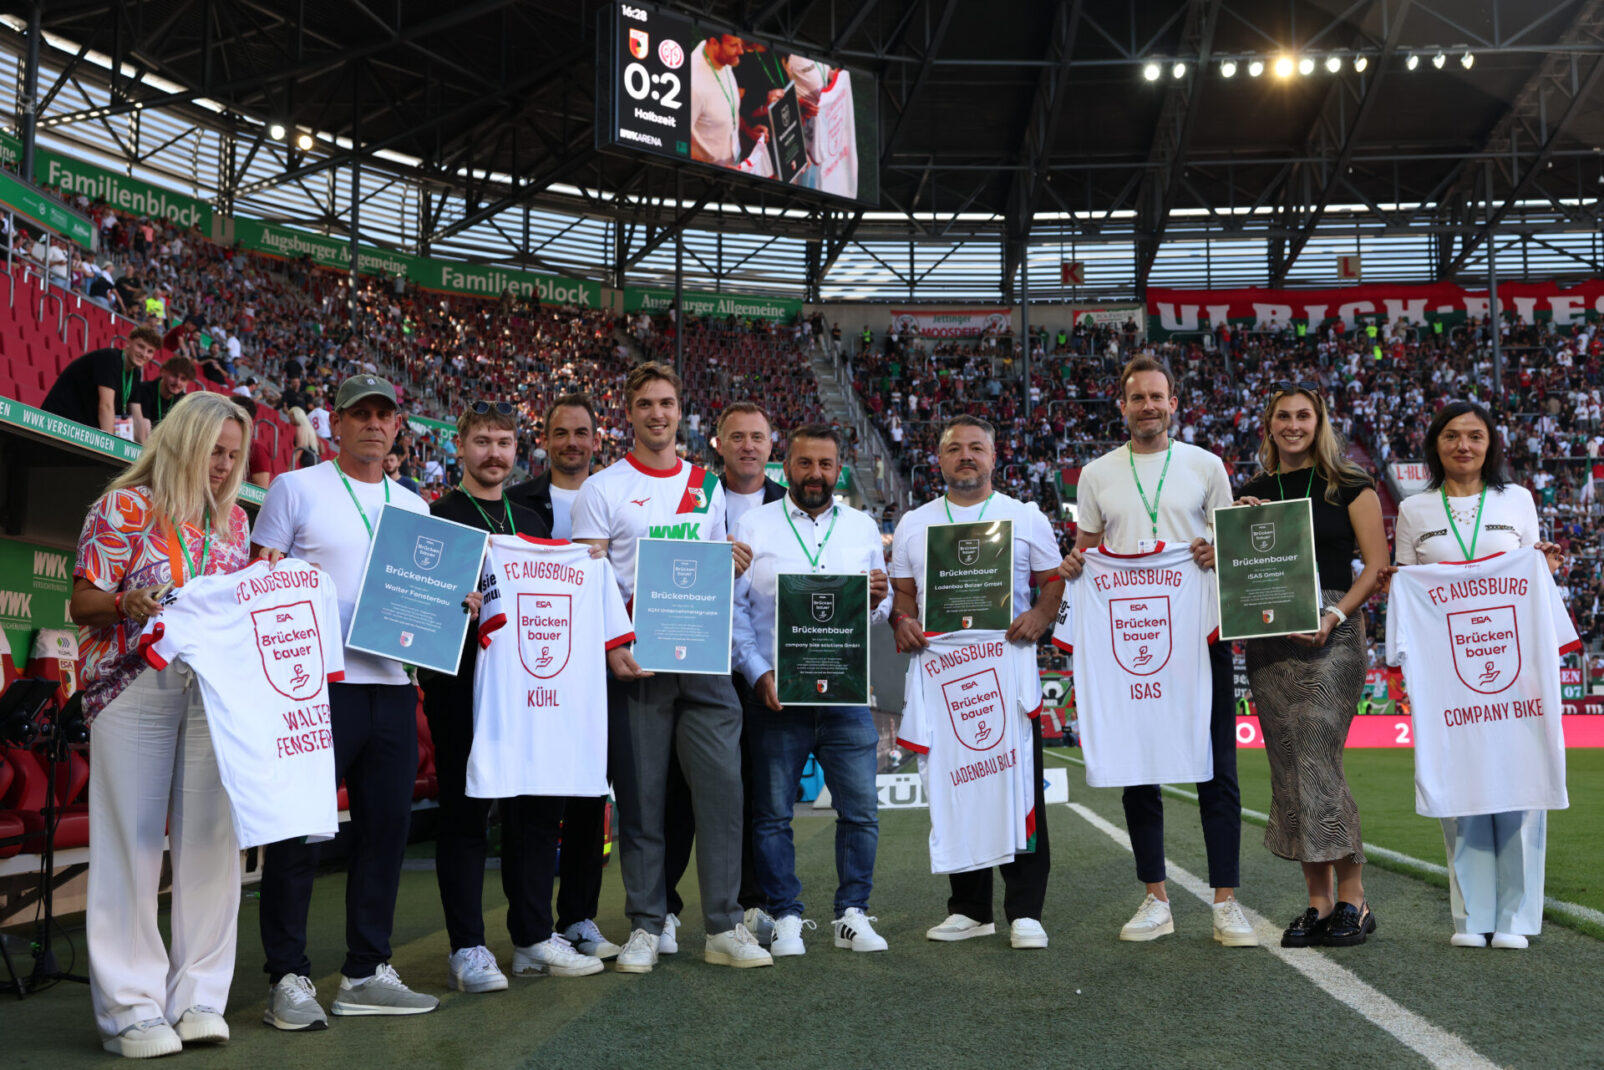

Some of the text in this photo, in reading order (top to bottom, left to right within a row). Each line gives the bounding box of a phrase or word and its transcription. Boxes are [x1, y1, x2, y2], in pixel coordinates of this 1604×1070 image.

[621, 4, 648, 22] 16:28
[624, 62, 683, 110] 0:2
[634, 107, 676, 128] Halbzeit
[49, 160, 201, 226] Familienblock
[261, 228, 408, 275] Augsburger Agemeine
[1062, 262, 1081, 283] K
[1343, 257, 1356, 277] L
[441, 267, 590, 305] Familienblock
[717, 300, 786, 317] Allgemeine
[1156, 296, 1604, 333] ULRICH-BIE
[0, 401, 11, 416] EN
[23, 409, 115, 451] WWK VERSICHERUNGEN
[649, 522, 701, 540] WWK
[33, 550, 68, 580] WWK
[1232, 554, 1298, 567] Brückenbauer
[386, 564, 458, 592] Brückenbauer
[504, 561, 584, 586] FC AUGSBURG
[939, 567, 998, 577] Brückenbauer
[1094, 569, 1183, 592] FC AUGSBURG
[236, 570, 319, 605] FC AUGSBURG
[384, 583, 409, 595] Walter
[410, 589, 450, 606] Fensterbau
[651, 591, 717, 602] Brückenbauer
[1428, 577, 1529, 605] FC AUGSBURG
[521, 616, 568, 627] Brücken
[792, 626, 854, 634] Brückenbauer
[1115, 618, 1167, 630] Brücken
[261, 627, 316, 647] Brücken
[528, 630, 562, 641] bauer
[1123, 631, 1160, 642] bauer
[1455, 629, 1514, 646] Brücken
[273, 644, 312, 661] bauer
[925, 641, 1004, 678] FC AUGSBURG
[1465, 644, 1507, 658] bauer
[1561, 670, 1581, 683] EN
[527, 686, 560, 707] KÜHL
[951, 690, 998, 712] Brücken
[1130, 682, 1162, 700] ISAS
[960, 704, 994, 721] bauer
[1444, 702, 1509, 727] COMPANY
[1513, 698, 1544, 719] BIKE
[950, 757, 998, 787] LADENBAU
